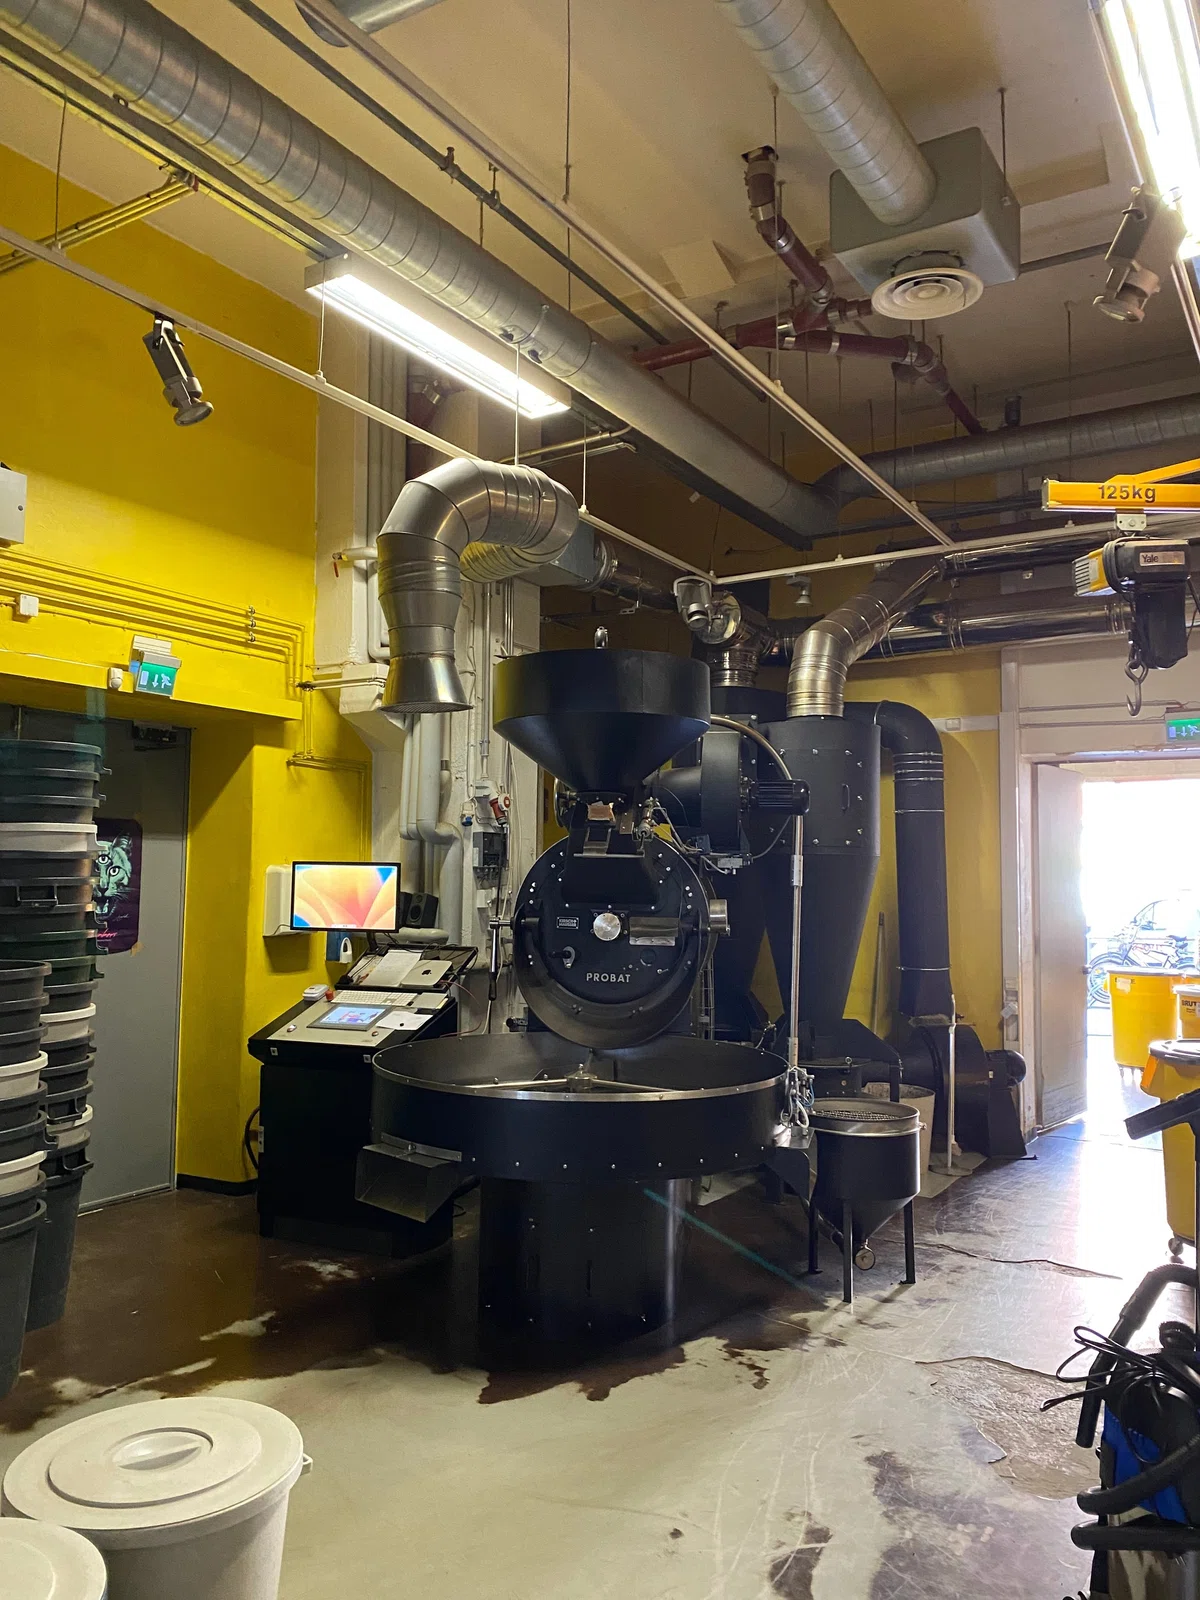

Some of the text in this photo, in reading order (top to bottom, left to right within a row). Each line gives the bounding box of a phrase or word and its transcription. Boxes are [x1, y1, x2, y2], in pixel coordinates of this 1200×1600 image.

[1098, 485, 1156, 503] 125kg
[1141, 554, 1159, 563] Yale
[586, 972, 631, 983] PROBAT
